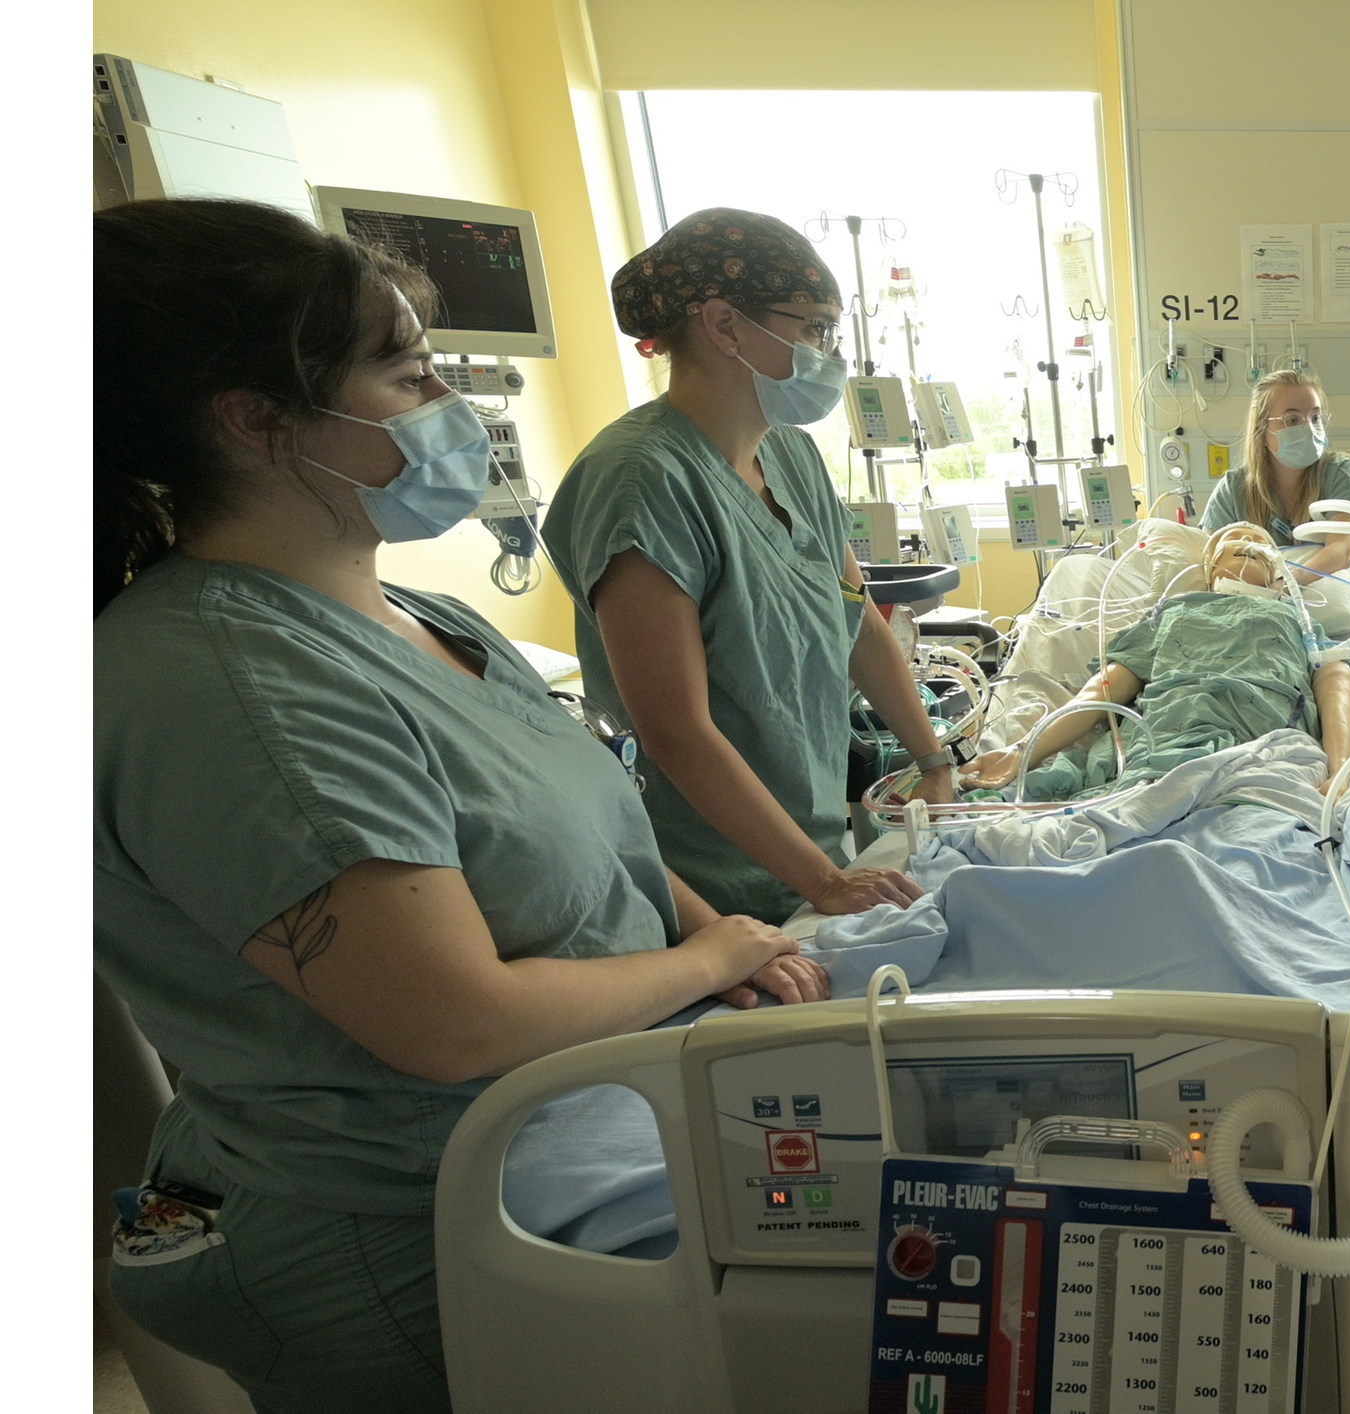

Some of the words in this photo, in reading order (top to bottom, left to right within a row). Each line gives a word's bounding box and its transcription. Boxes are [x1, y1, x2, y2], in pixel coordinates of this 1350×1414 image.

[1161, 294, 1240, 321] SI-12
[487, 519, 521, 548] LONG
[777, 1148, 810, 1156] BRAKE
[772, 1192, 787, 1204] N
[812, 1190, 823, 1203] D
[892, 1180, 999, 1211] PLEUR-EVAC
[1079, 1200, 1099, 1209] Chest
[1100, 1202, 1132, 1213] Drainage
[1133, 1203, 1159, 1213] System
[757, 1222, 802, 1231] PATENT
[807, 1220, 860, 1229] PENDING
[1063, 1233, 1095, 1244] 2500
[1133, 1238, 1164, 1249] 1600
[1201, 1245, 1225, 1255] 640
[1061, 1283, 1093, 1294] 2400
[1249, 1279, 1272, 1290] 180
[1131, 1285, 1161, 1296] 1500
[1199, 1285, 1223, 1296] 600
[1248, 1313, 1271, 1324] 160
[1058, 1332, 1090, 1344] 2300
[1128, 1331, 1158, 1342] 1400
[1196, 1335, 1220, 1346] 550
[878, 1347, 903, 1361] REF
[904, 1349, 915, 1362] A
[924, 1351, 984, 1367] 6000-08LF
[1246, 1348, 1269, 1359] 140
[1055, 1382, 1087, 1394] 2200
[1126, 1378, 1156, 1389] 1300
[1244, 1383, 1267, 1394] 120
[1193, 1387, 1218, 1397] 500
